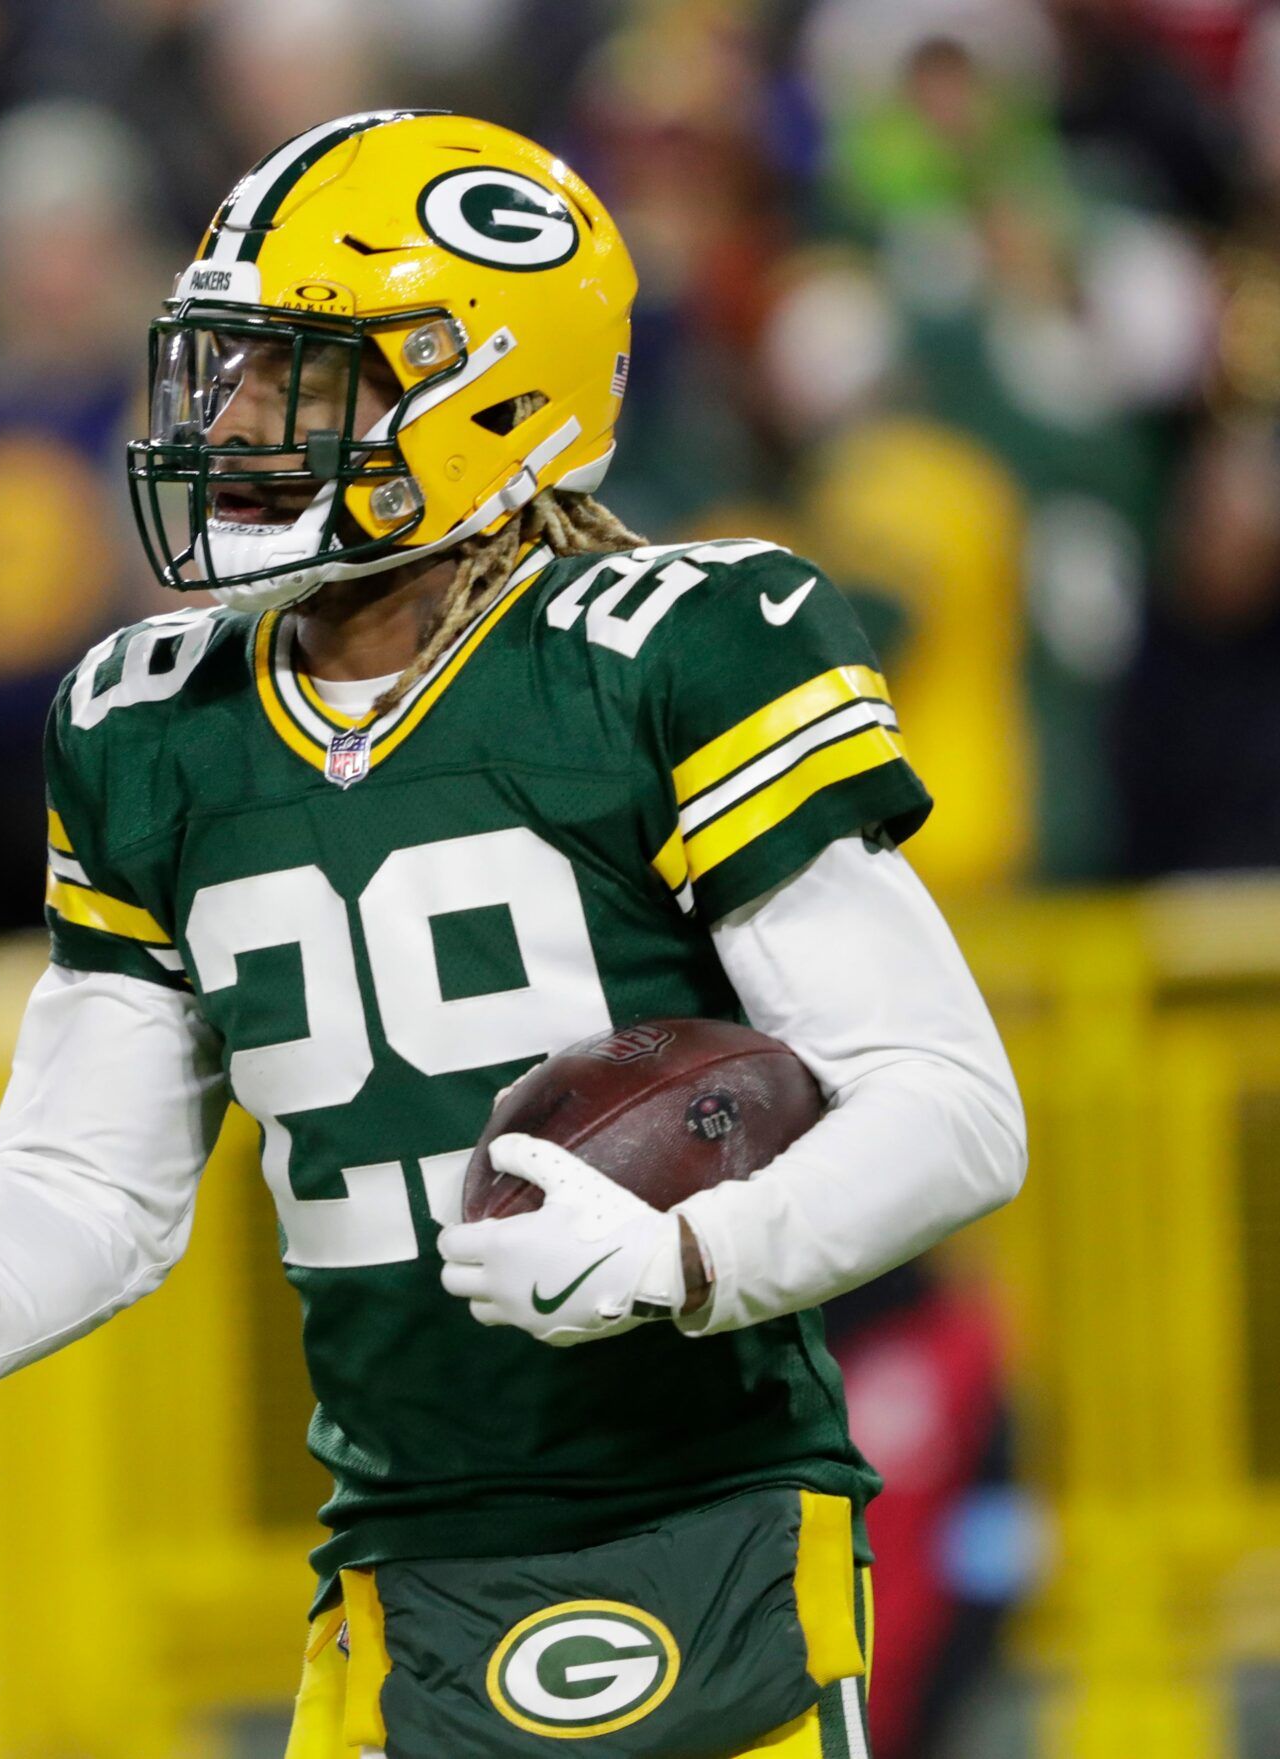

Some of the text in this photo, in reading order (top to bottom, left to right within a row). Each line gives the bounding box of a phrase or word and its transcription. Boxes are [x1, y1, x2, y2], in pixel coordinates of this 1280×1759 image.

[189, 271, 232, 291] PACKERS
[331, 752, 361, 779] NFL
[185, 826, 613, 1268] 29
